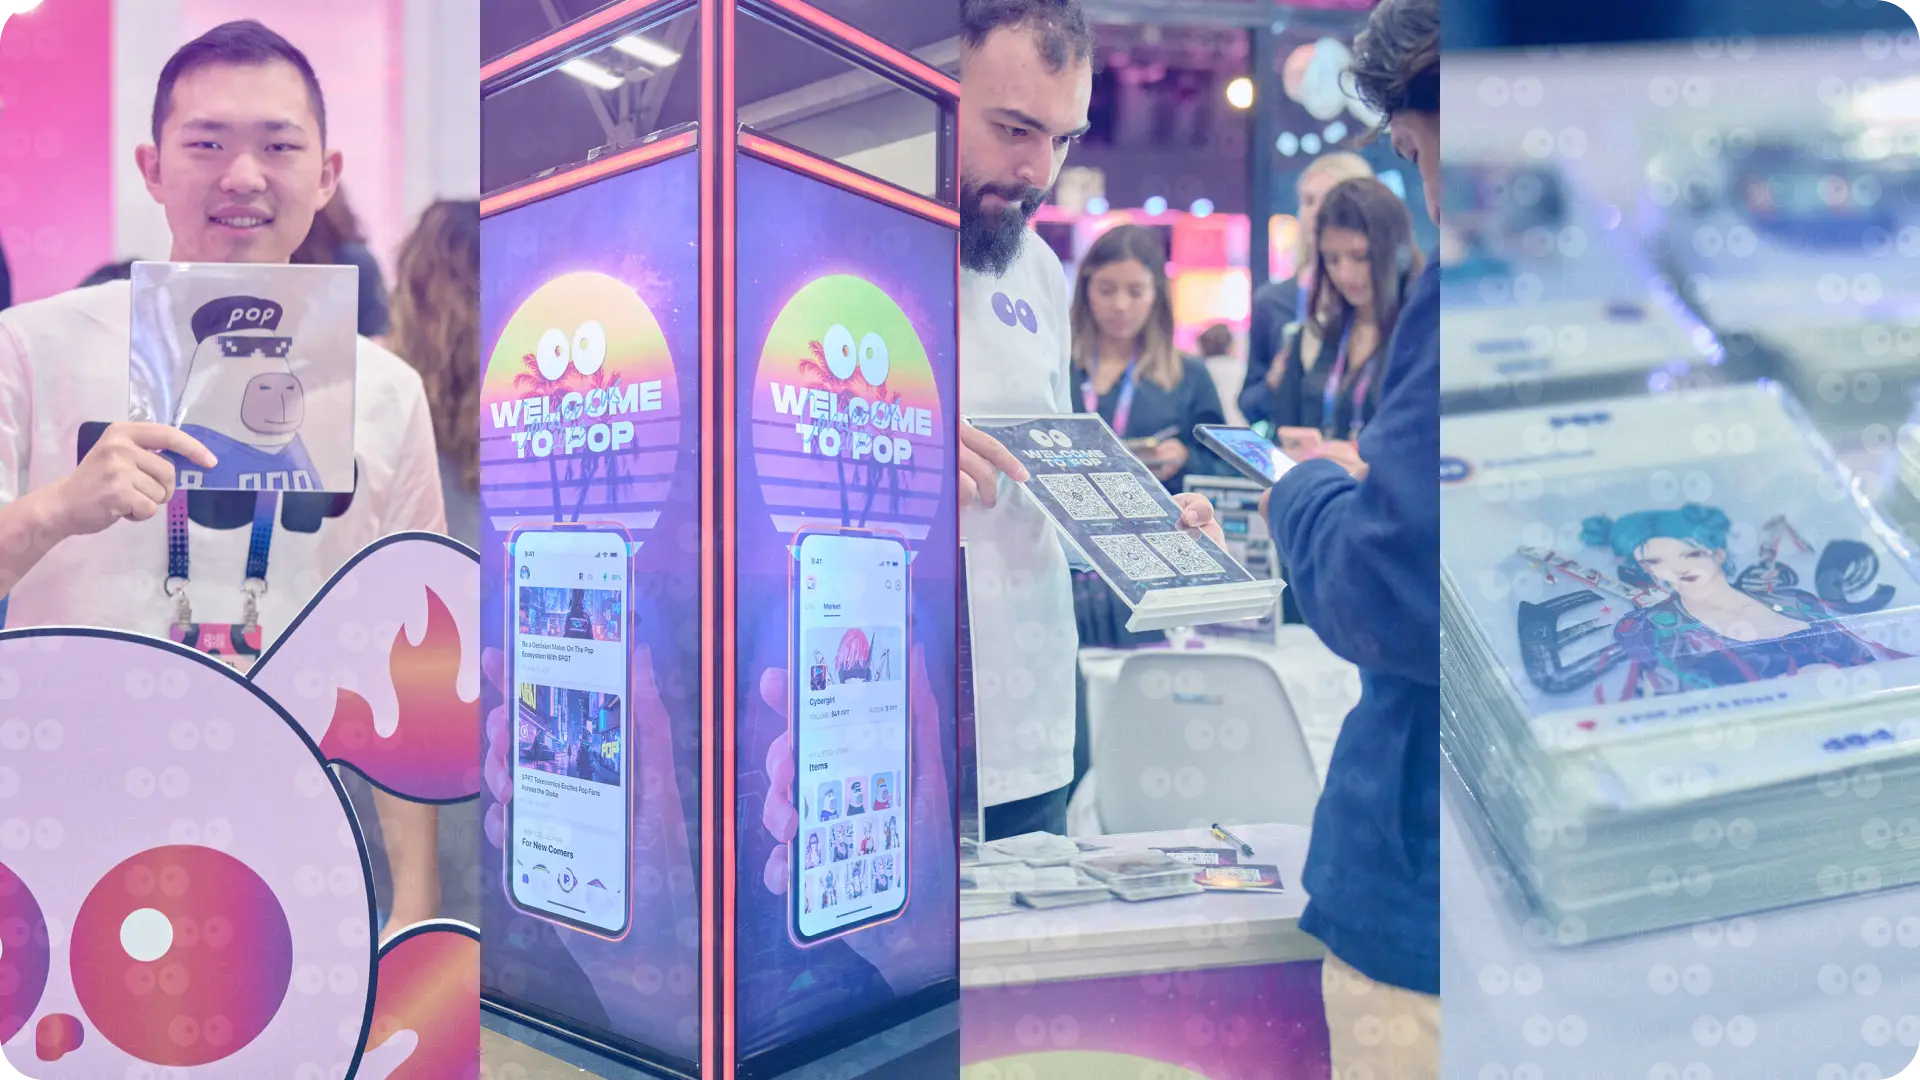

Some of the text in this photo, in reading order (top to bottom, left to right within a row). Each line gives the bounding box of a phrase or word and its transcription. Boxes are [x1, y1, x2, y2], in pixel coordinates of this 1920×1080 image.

[490, 380, 662, 428] WELCOME
[770, 382, 932, 436] WELCOME
[512, 420, 635, 458] TO POP
[796, 423, 912, 464] TO POP
[1021, 449, 1107, 459] WELCOME
[522, 651, 546, 660] Ecosystem
[532, 641, 551, 650] Decision
[584, 646, 595, 654] Pop
[809, 762, 828, 772] Items
[521, 784, 536, 794] Across
[545, 789, 558, 798] Globe
[534, 776, 560, 788] Tokenomics
[561, 782, 578, 792] Excites
[578, 786, 588, 794] Pop
[589, 788, 600, 796] Fans
[522, 837, 574, 859] For New Comers
